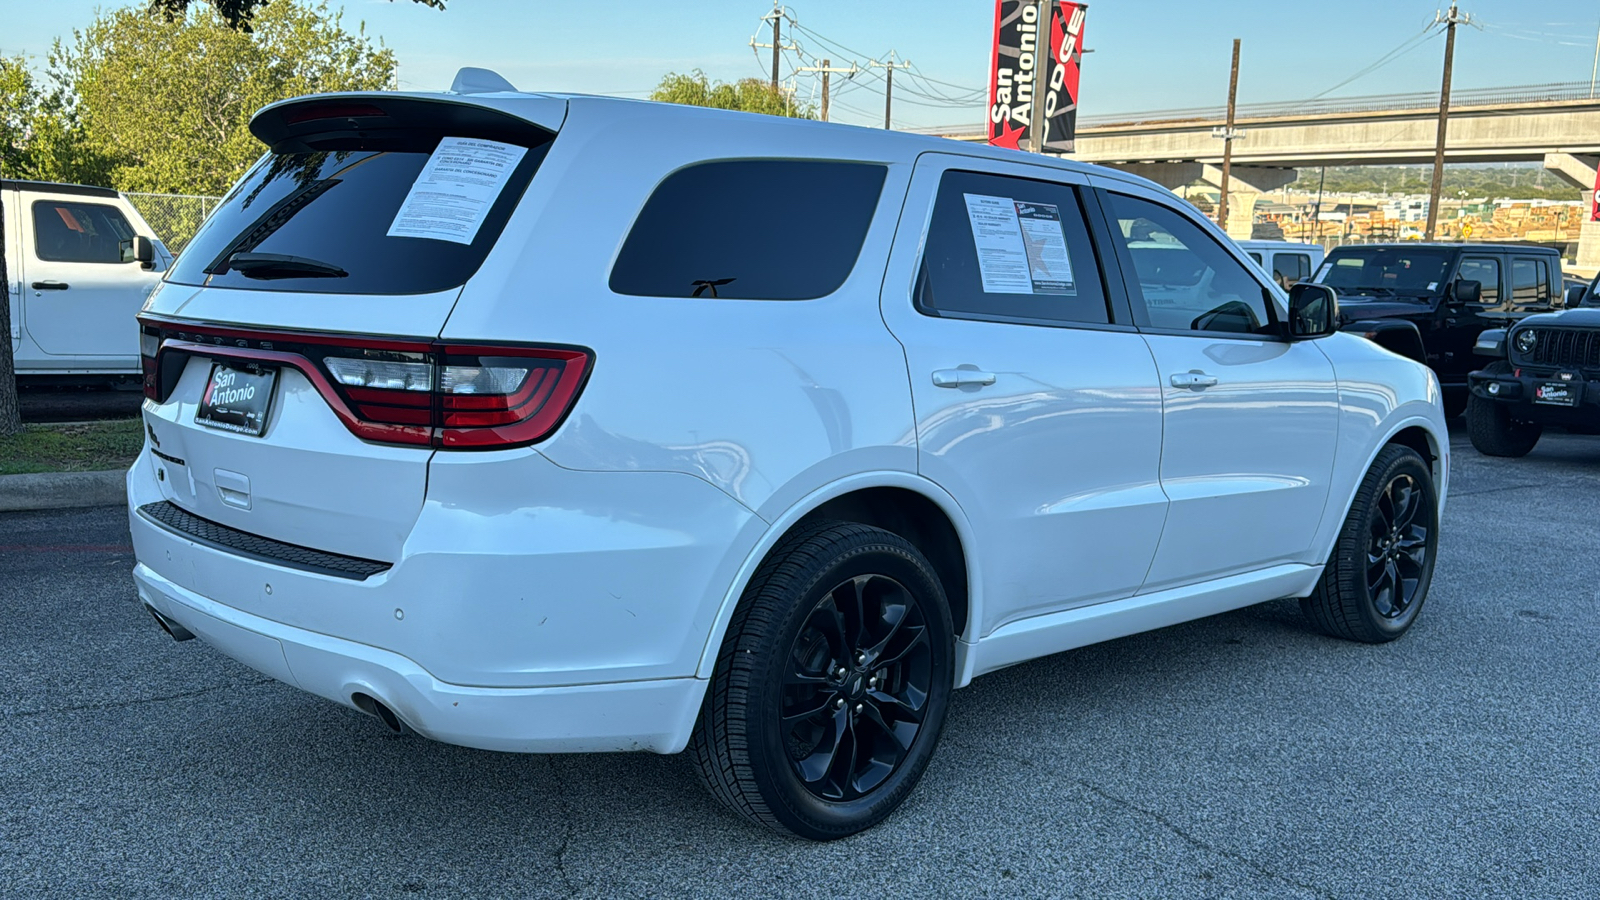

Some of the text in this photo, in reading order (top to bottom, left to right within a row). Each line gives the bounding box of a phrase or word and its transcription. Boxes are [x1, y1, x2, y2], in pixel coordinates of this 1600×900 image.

[1011, 5, 1038, 126] Antonio
[991, 68, 1013, 124] San
[213, 371, 235, 389] San
[209, 383, 255, 407] Antonio
[1541, 390, 1568, 398] Antonio
[195, 417, 258, 435] SanAntonioDodge.com
